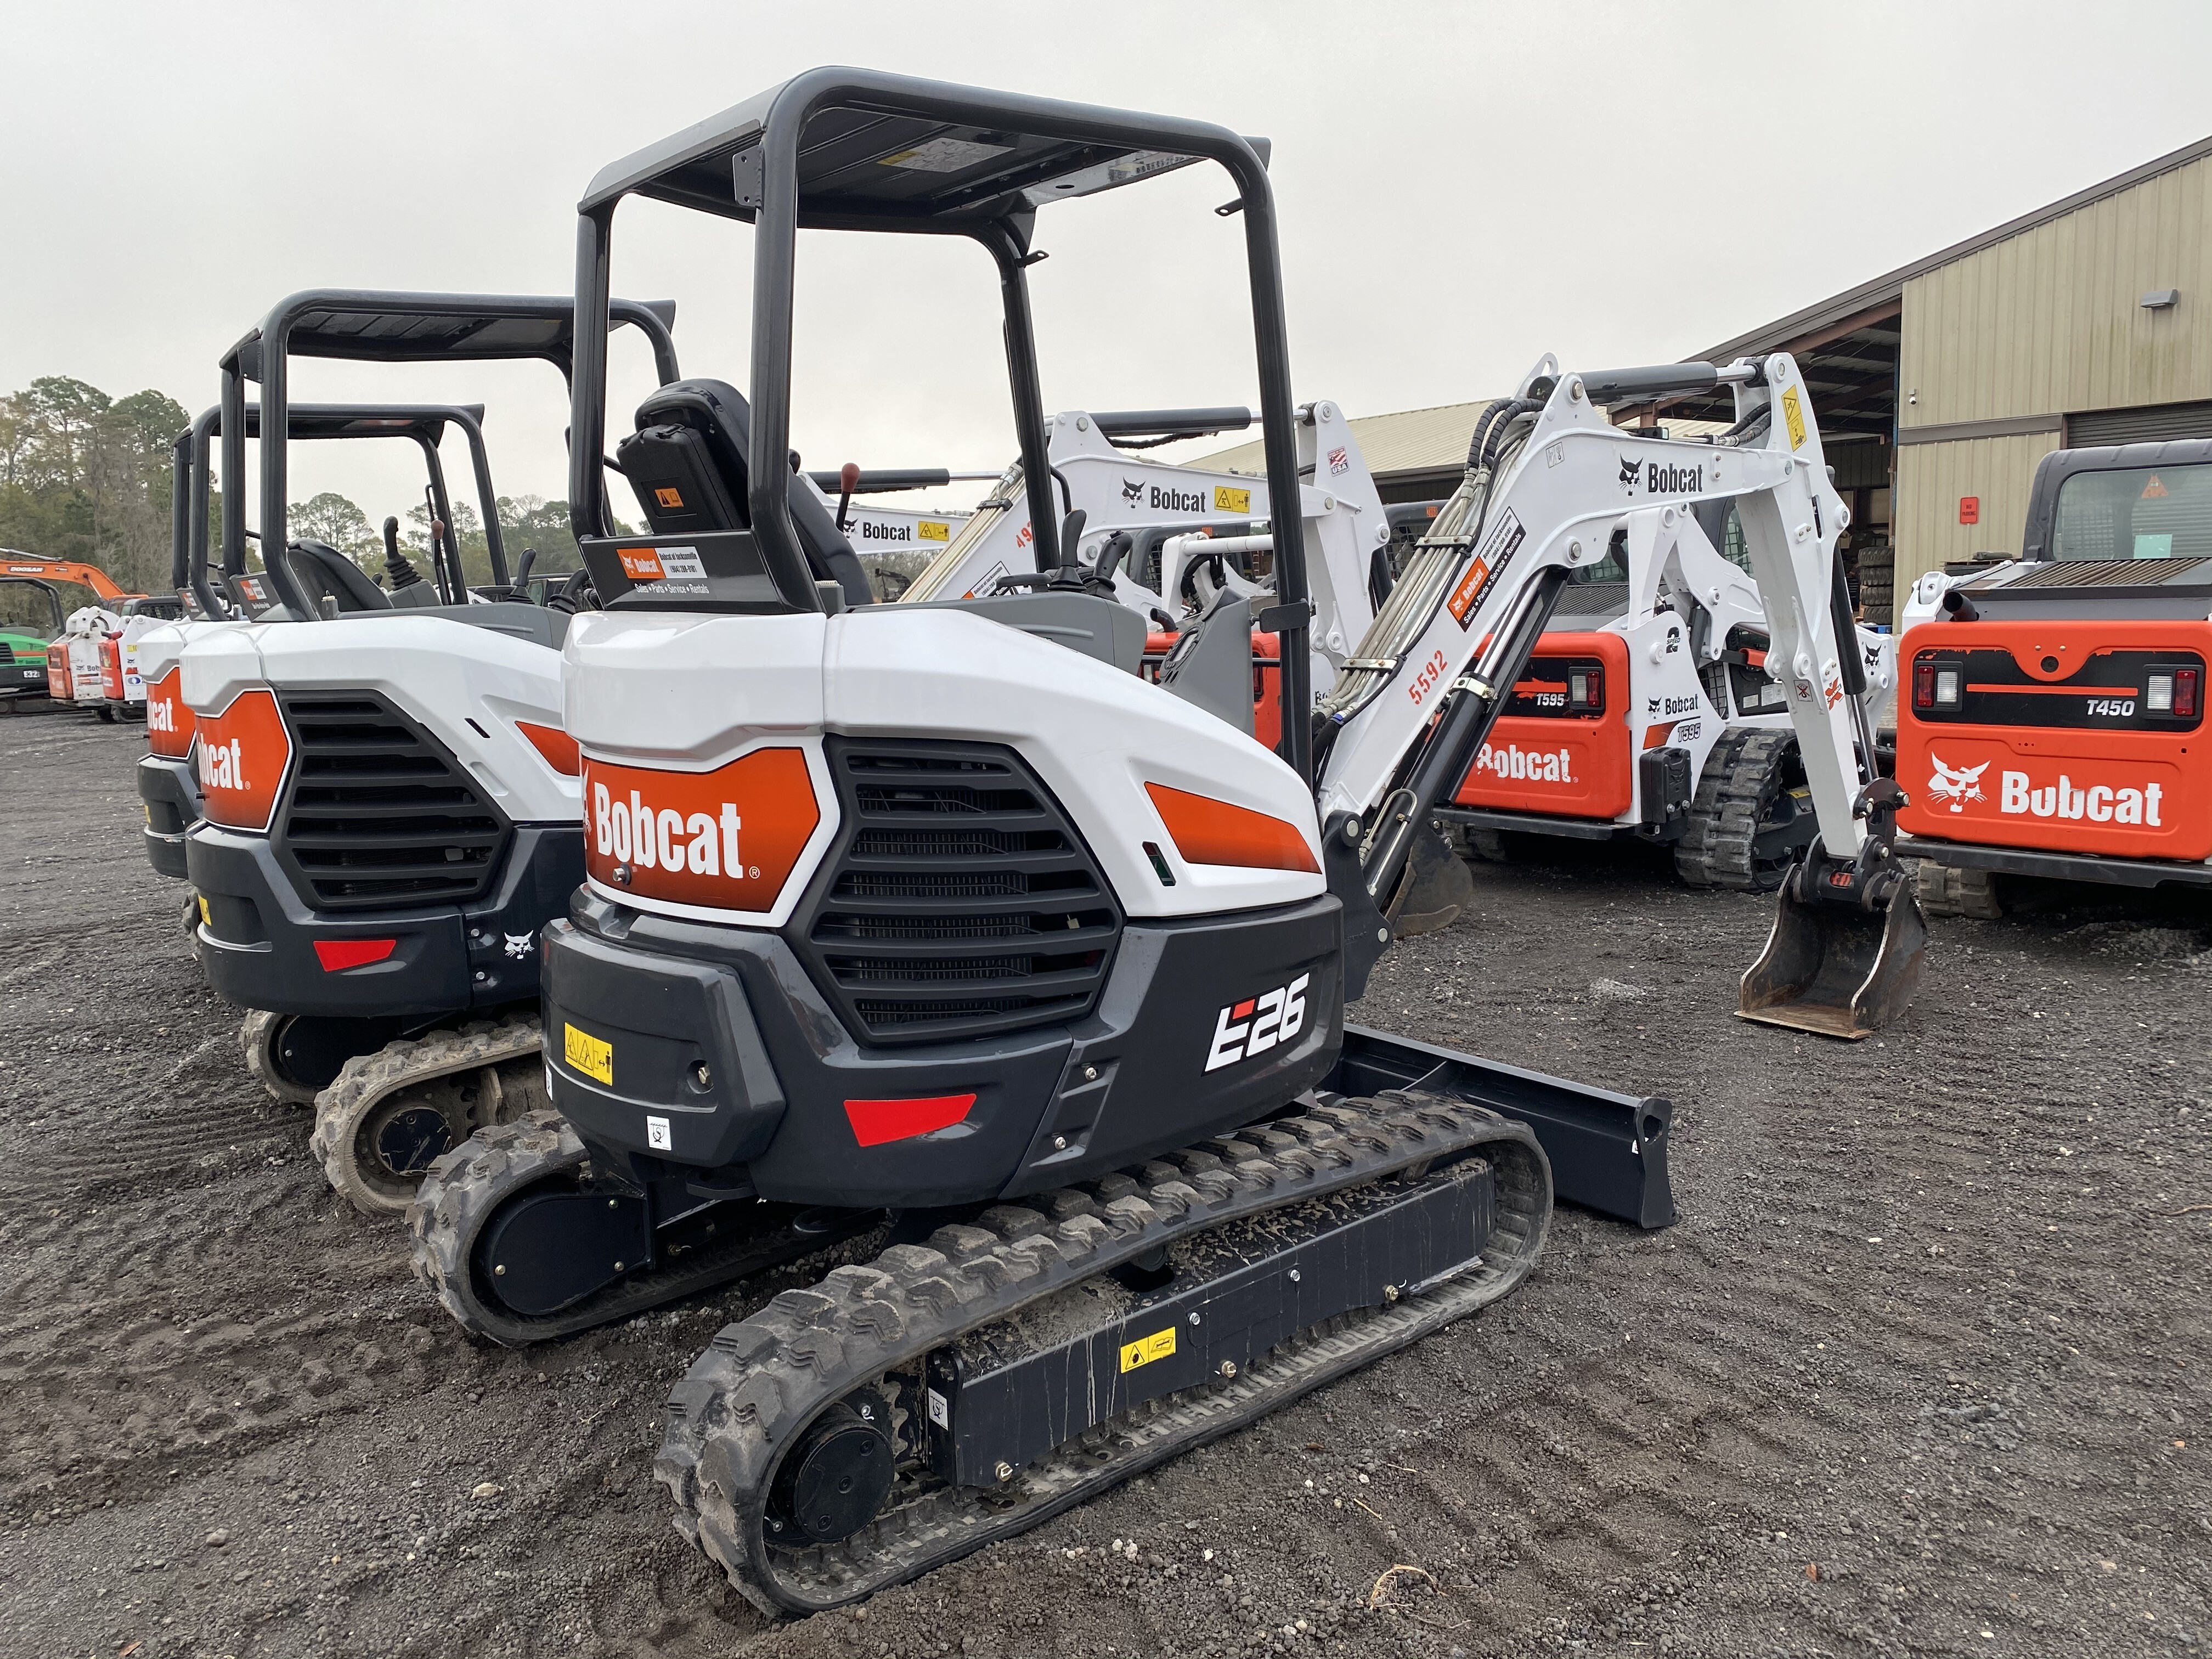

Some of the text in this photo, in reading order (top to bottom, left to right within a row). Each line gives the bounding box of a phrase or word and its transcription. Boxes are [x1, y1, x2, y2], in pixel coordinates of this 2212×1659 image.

[1332, 463, 1348, 473] USA
[1648, 463, 1702, 493] Bobcat
[1150, 486, 1206, 512] Bobcat
[863, 522, 911, 541] Bobcat
[1483, 543, 1494, 559] Bobcat
[1495, 514, 1512, 540] Jacksonville
[634, 558, 659, 573] Bobcat
[1464, 533, 1522, 624] Sales Parts Service Rentals
[635, 583, 709, 594] Sales Parts Service Rentals
[974, 583, 985, 594] Bobcat
[1462, 568, 1485, 601] Bobcat
[1409, 650, 1447, 704] 5592
[1536, 693, 1565, 706] T595
[1666, 693, 1698, 715] Bobcat
[2087, 699, 2135, 716] T450
[1678, 722, 1701, 742] T595
[1477, 743, 1571, 783] Bobcat
[2001, 770, 2162, 827] Bobcat
[594, 782, 743, 878] Bobcat
[1205, 972, 1310, 1073] E26
